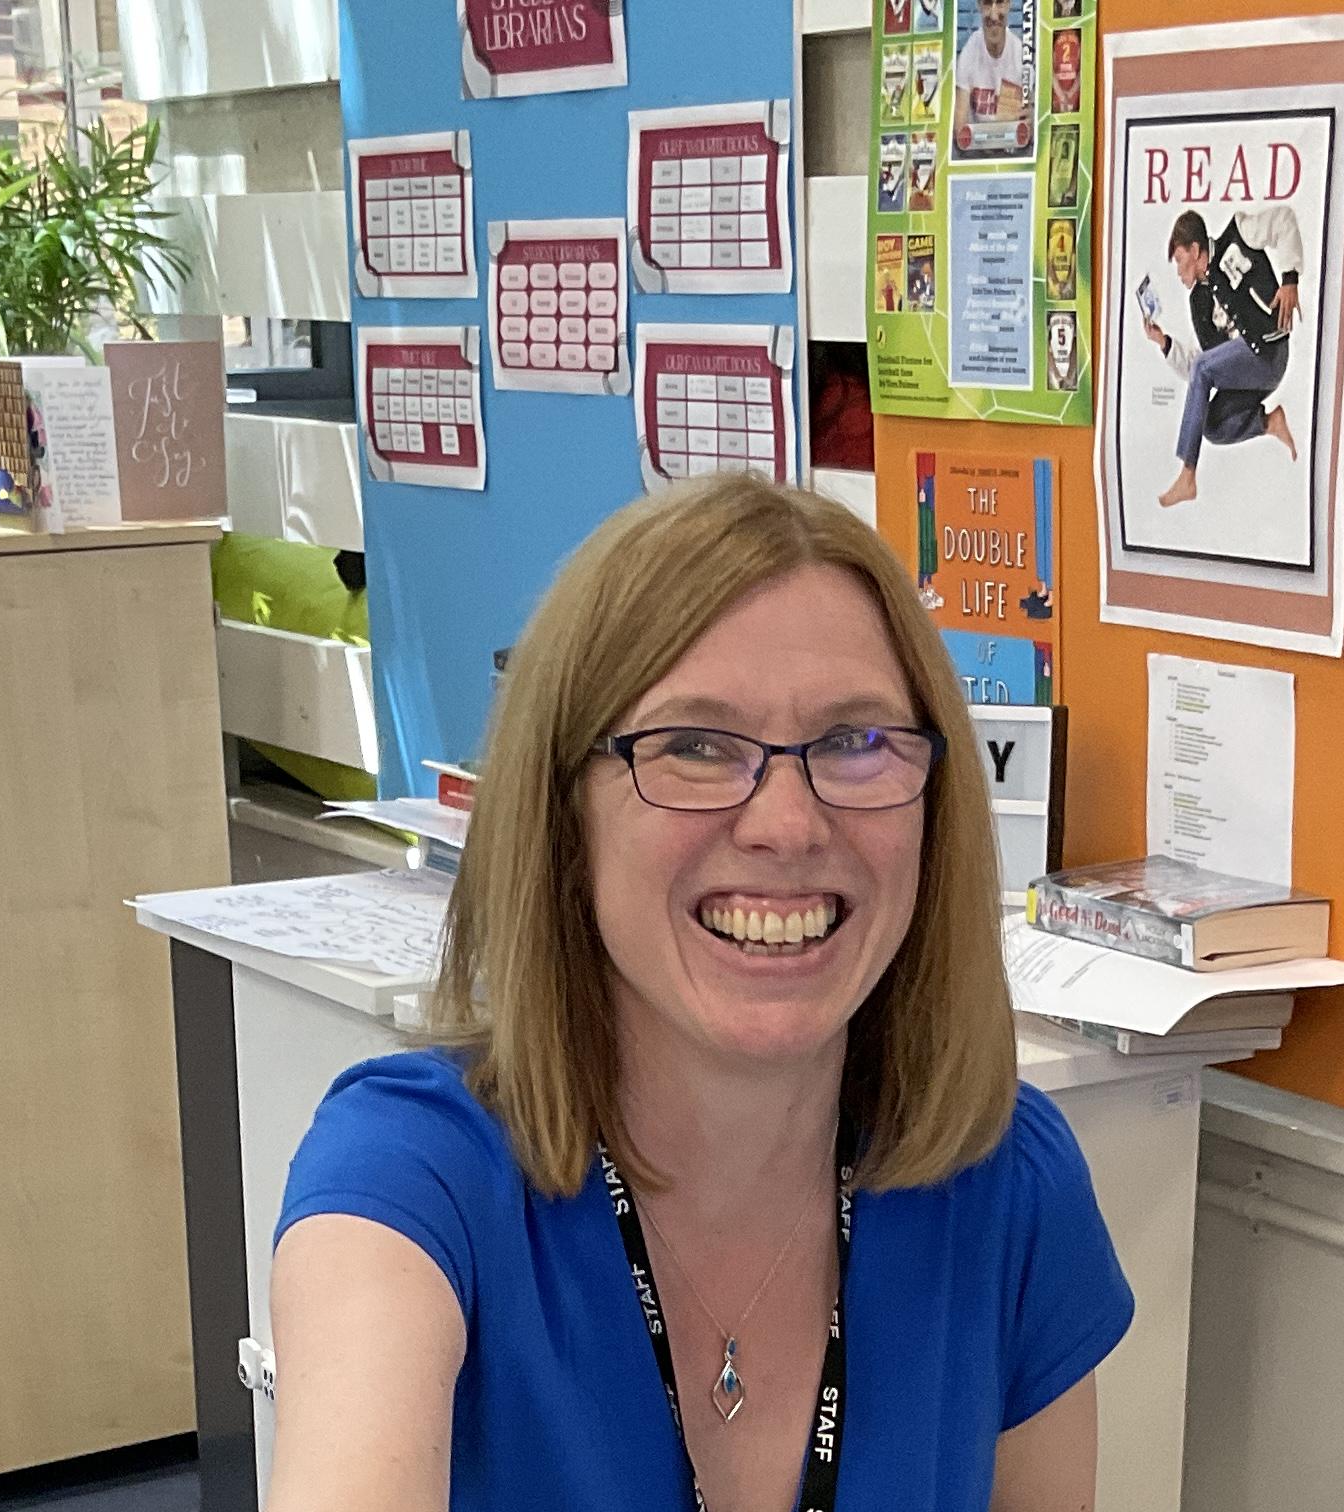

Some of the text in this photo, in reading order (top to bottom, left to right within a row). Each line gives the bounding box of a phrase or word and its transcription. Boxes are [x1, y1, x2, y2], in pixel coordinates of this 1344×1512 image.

[1143, 143, 1301, 204] READ
[967, 487, 997, 516] THE
[943, 525, 1026, 568] DOUBLE
[961, 580, 1007, 618] LIFE
[631, 1263, 663, 1335] STAFF
[815, 1386, 838, 1463] STAFF
